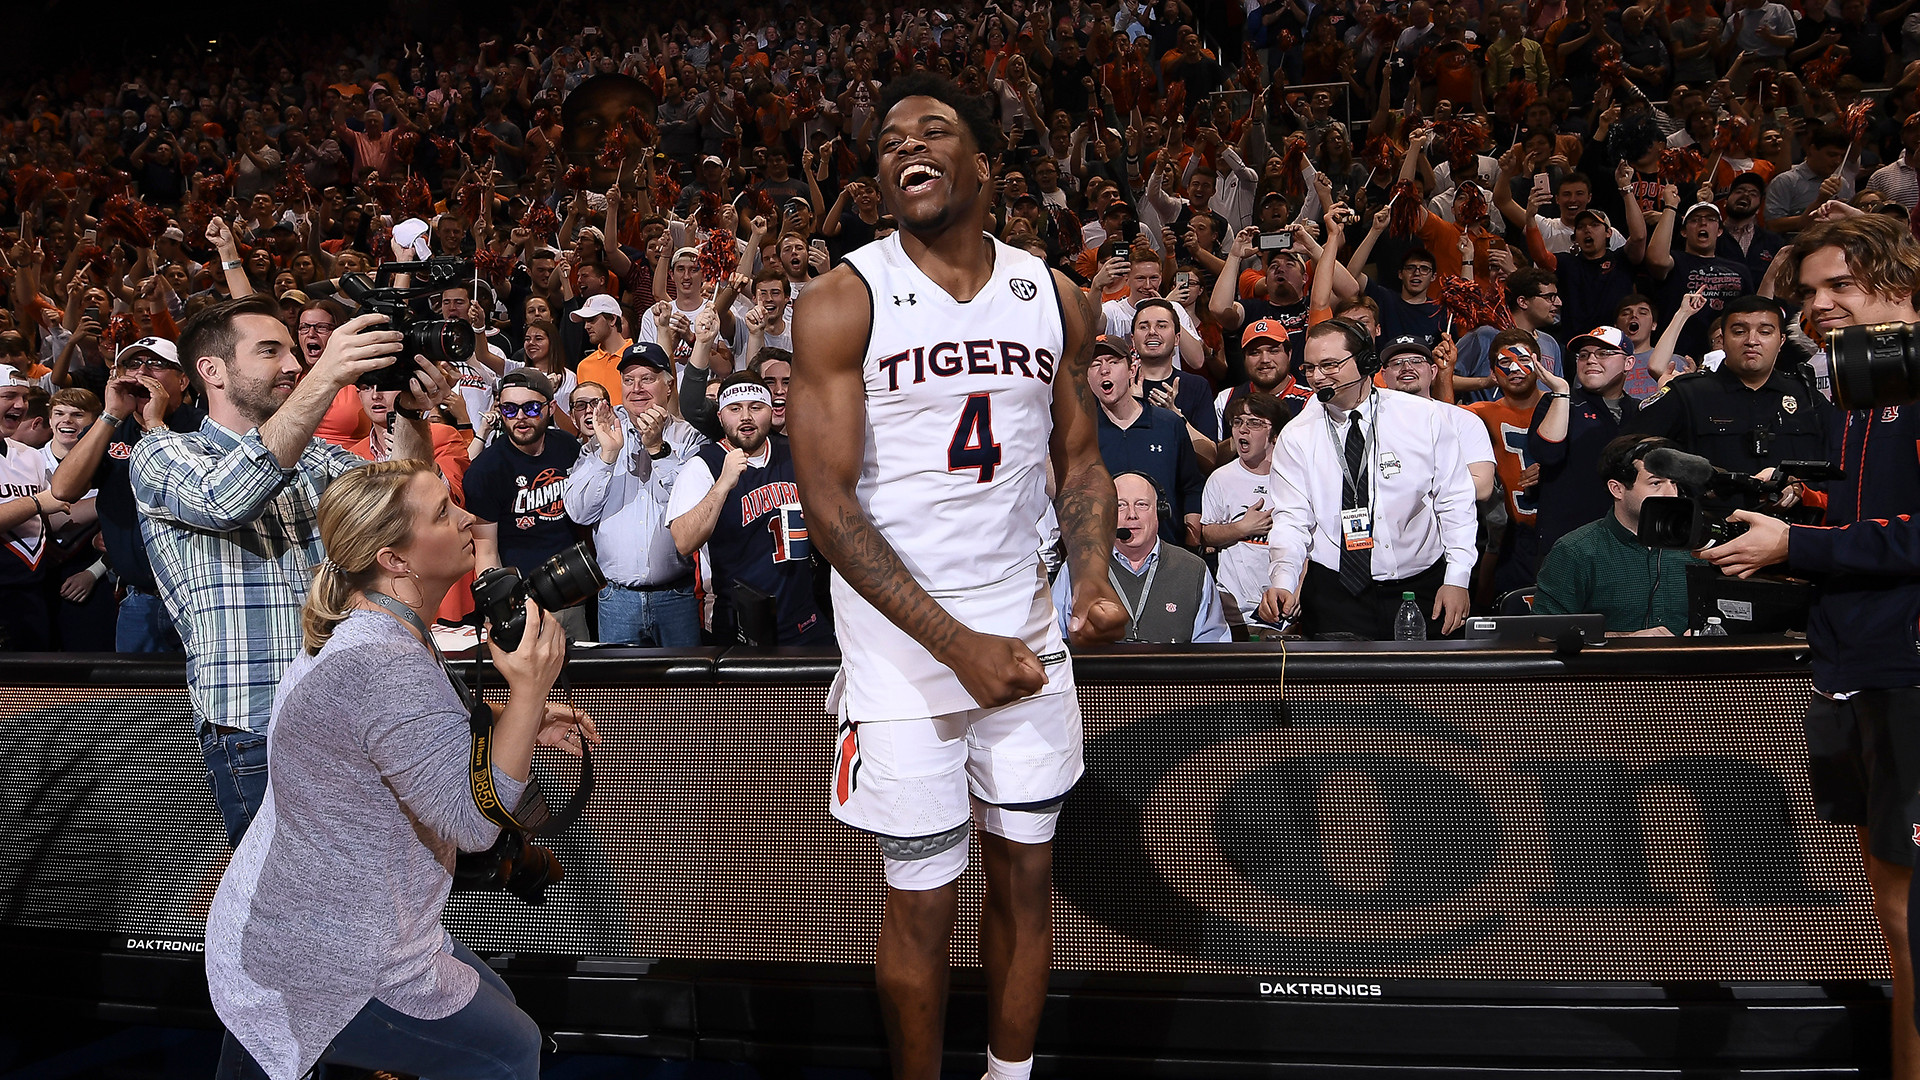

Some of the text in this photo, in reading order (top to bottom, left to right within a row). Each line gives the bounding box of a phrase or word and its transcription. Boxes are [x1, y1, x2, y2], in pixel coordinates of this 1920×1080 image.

[1010, 279, 1037, 301] SEC
[879, 338, 1055, 392] TIGERS
[722, 384, 764, 400] AUBURN
[947, 393, 1002, 484] 4
[1343, 512, 1368, 520] AUBURN
[474, 737, 496, 810] Nikon D850
[127, 938, 204, 952] DAKTRONIC
[1259, 982, 1382, 996] DAKTRONICS
